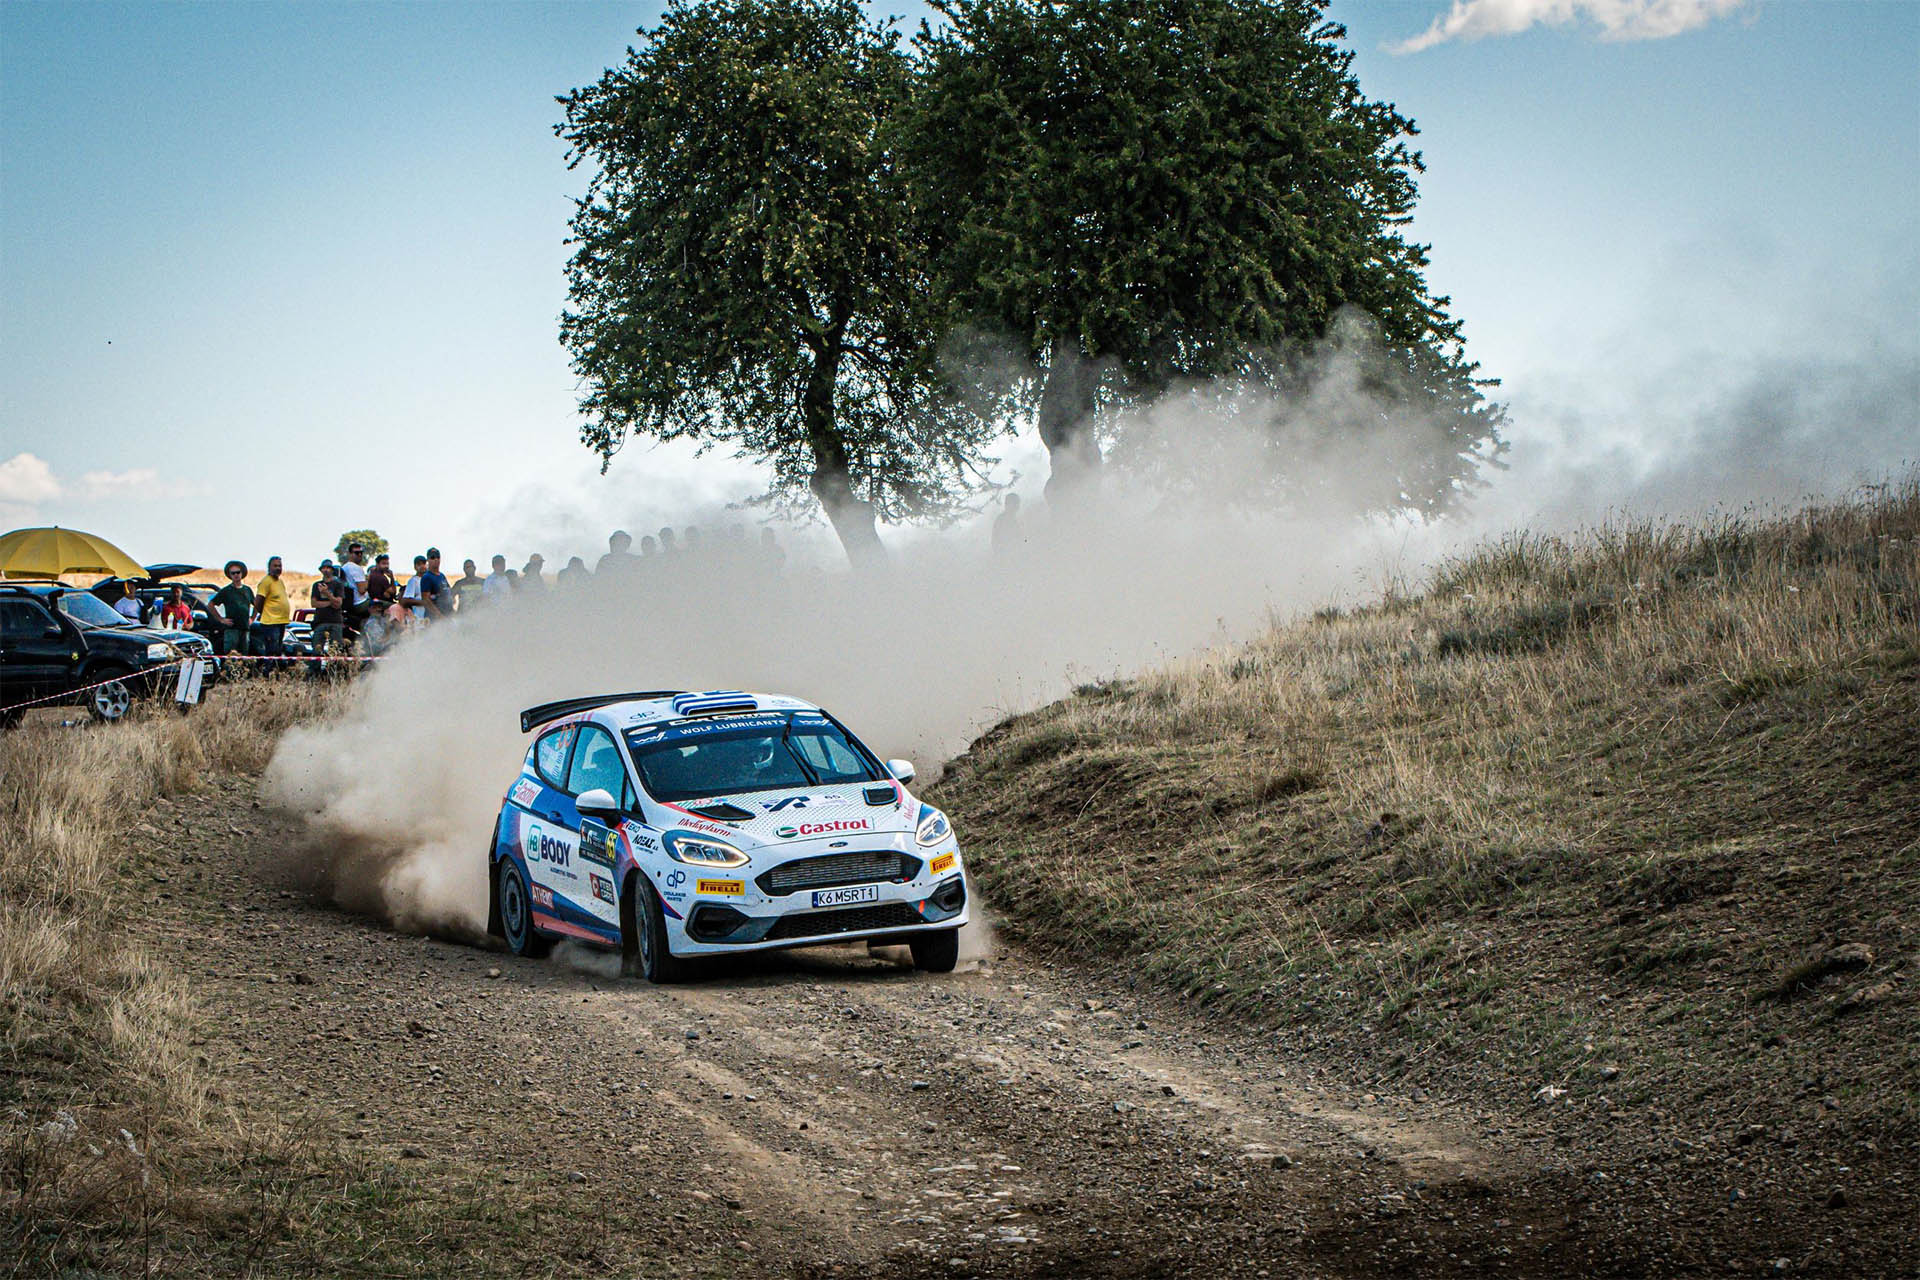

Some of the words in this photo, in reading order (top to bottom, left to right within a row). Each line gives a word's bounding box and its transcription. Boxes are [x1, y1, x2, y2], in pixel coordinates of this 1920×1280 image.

[680, 725, 713, 735] WOLF
[715, 719, 787, 730] LUBRICANTS
[799, 819, 870, 835] Castrol
[541, 834, 571, 868] BODY
[607, 831, 618, 860] 65
[933, 856, 954, 872] PIRELLI
[700, 881, 740, 893] PIRELLI
[818, 893, 833, 905] K6
